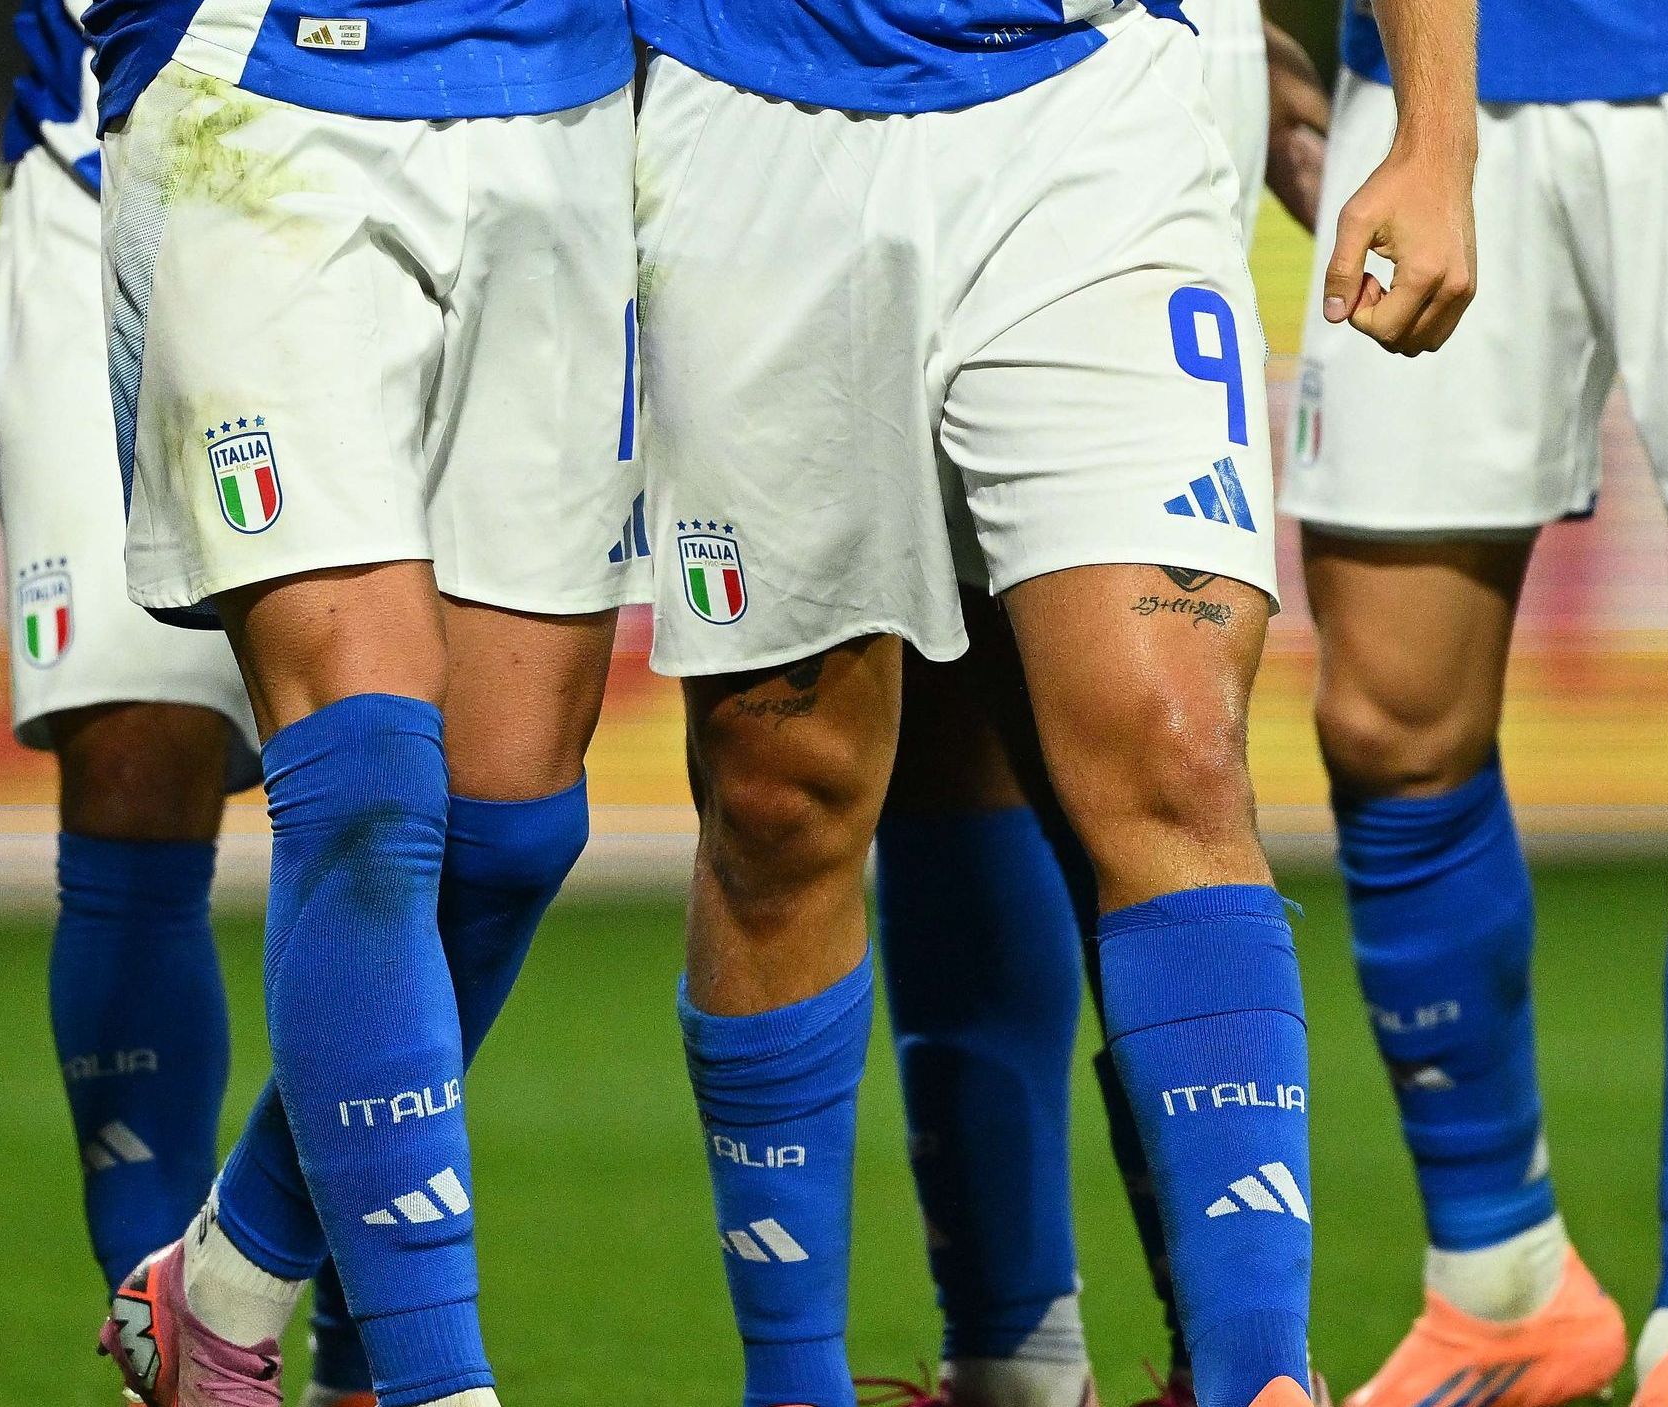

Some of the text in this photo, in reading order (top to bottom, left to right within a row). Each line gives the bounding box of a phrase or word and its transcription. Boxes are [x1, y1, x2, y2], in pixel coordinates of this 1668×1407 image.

[618, 298, 634, 462] 1
[1168, 286, 1248, 446] 9
[214, 440, 267, 468] ITALIA
[684, 542, 734, 560] ITALIA
[339, 1078, 461, 1127] ITALIA
[1162, 1082, 1305, 1115] ITALIA
[713, 1135, 805, 1168] ALIA
